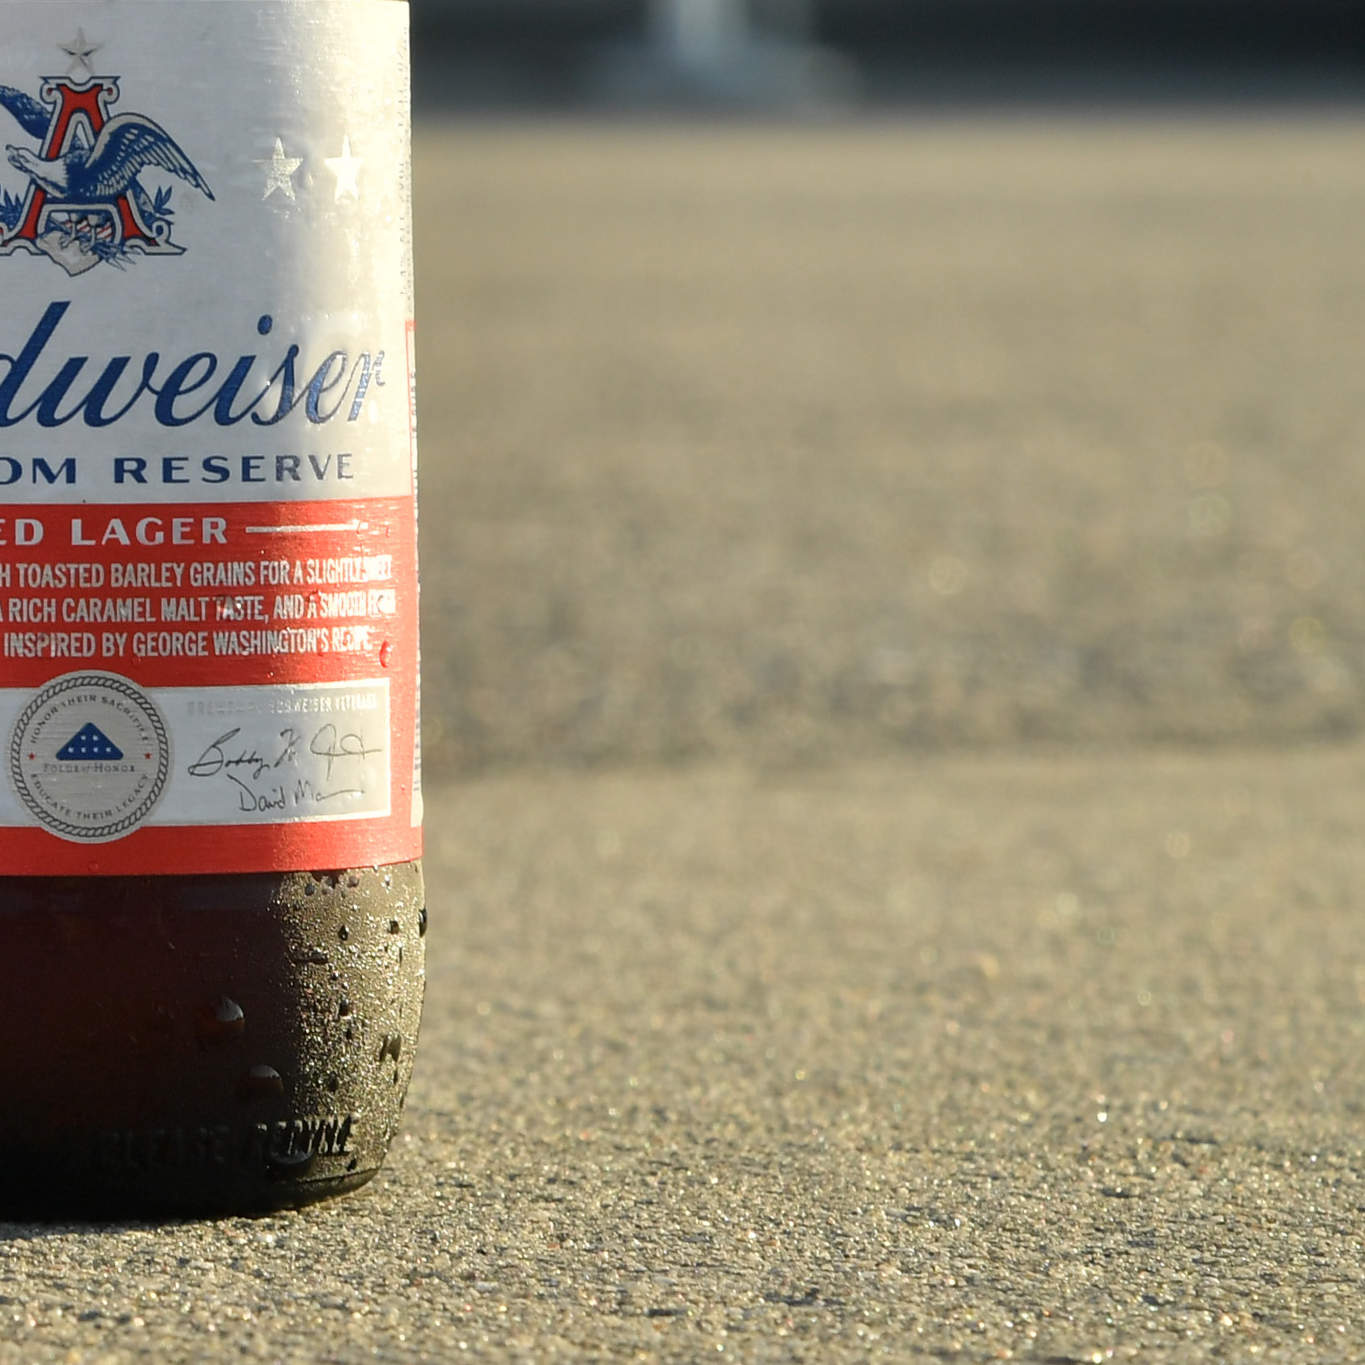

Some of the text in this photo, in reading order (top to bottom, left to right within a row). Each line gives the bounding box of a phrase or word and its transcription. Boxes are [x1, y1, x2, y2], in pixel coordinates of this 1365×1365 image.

[113, 453, 354, 484] RESERVE
[70, 517, 229, 546] LAGER
[16, 563, 105, 589] TOASTED
[110, 562, 186, 588] BARLEY
[189, 561, 256, 587] GRAINS
[259, 559, 290, 585] FOR
[293, 559, 304, 585] A
[306, 556, 362, 584] SLIGHTLY
[8, 598, 57, 623] RICH
[62, 597, 157, 623] CARAMEL
[161, 596, 209, 622] MALT
[213, 595, 270, 625] TASTE,
[273, 593, 305, 620] AND
[3, 632, 96, 657] INSPIRED
[102, 632, 126, 657] BY
[132, 631, 209, 656] GEORGE
[213, 627, 329, 655] WASHINGTON'S
[29, 706, 59, 744] HONOR
[31, 773, 150, 821] EDUCATE THEIR LEGACY
